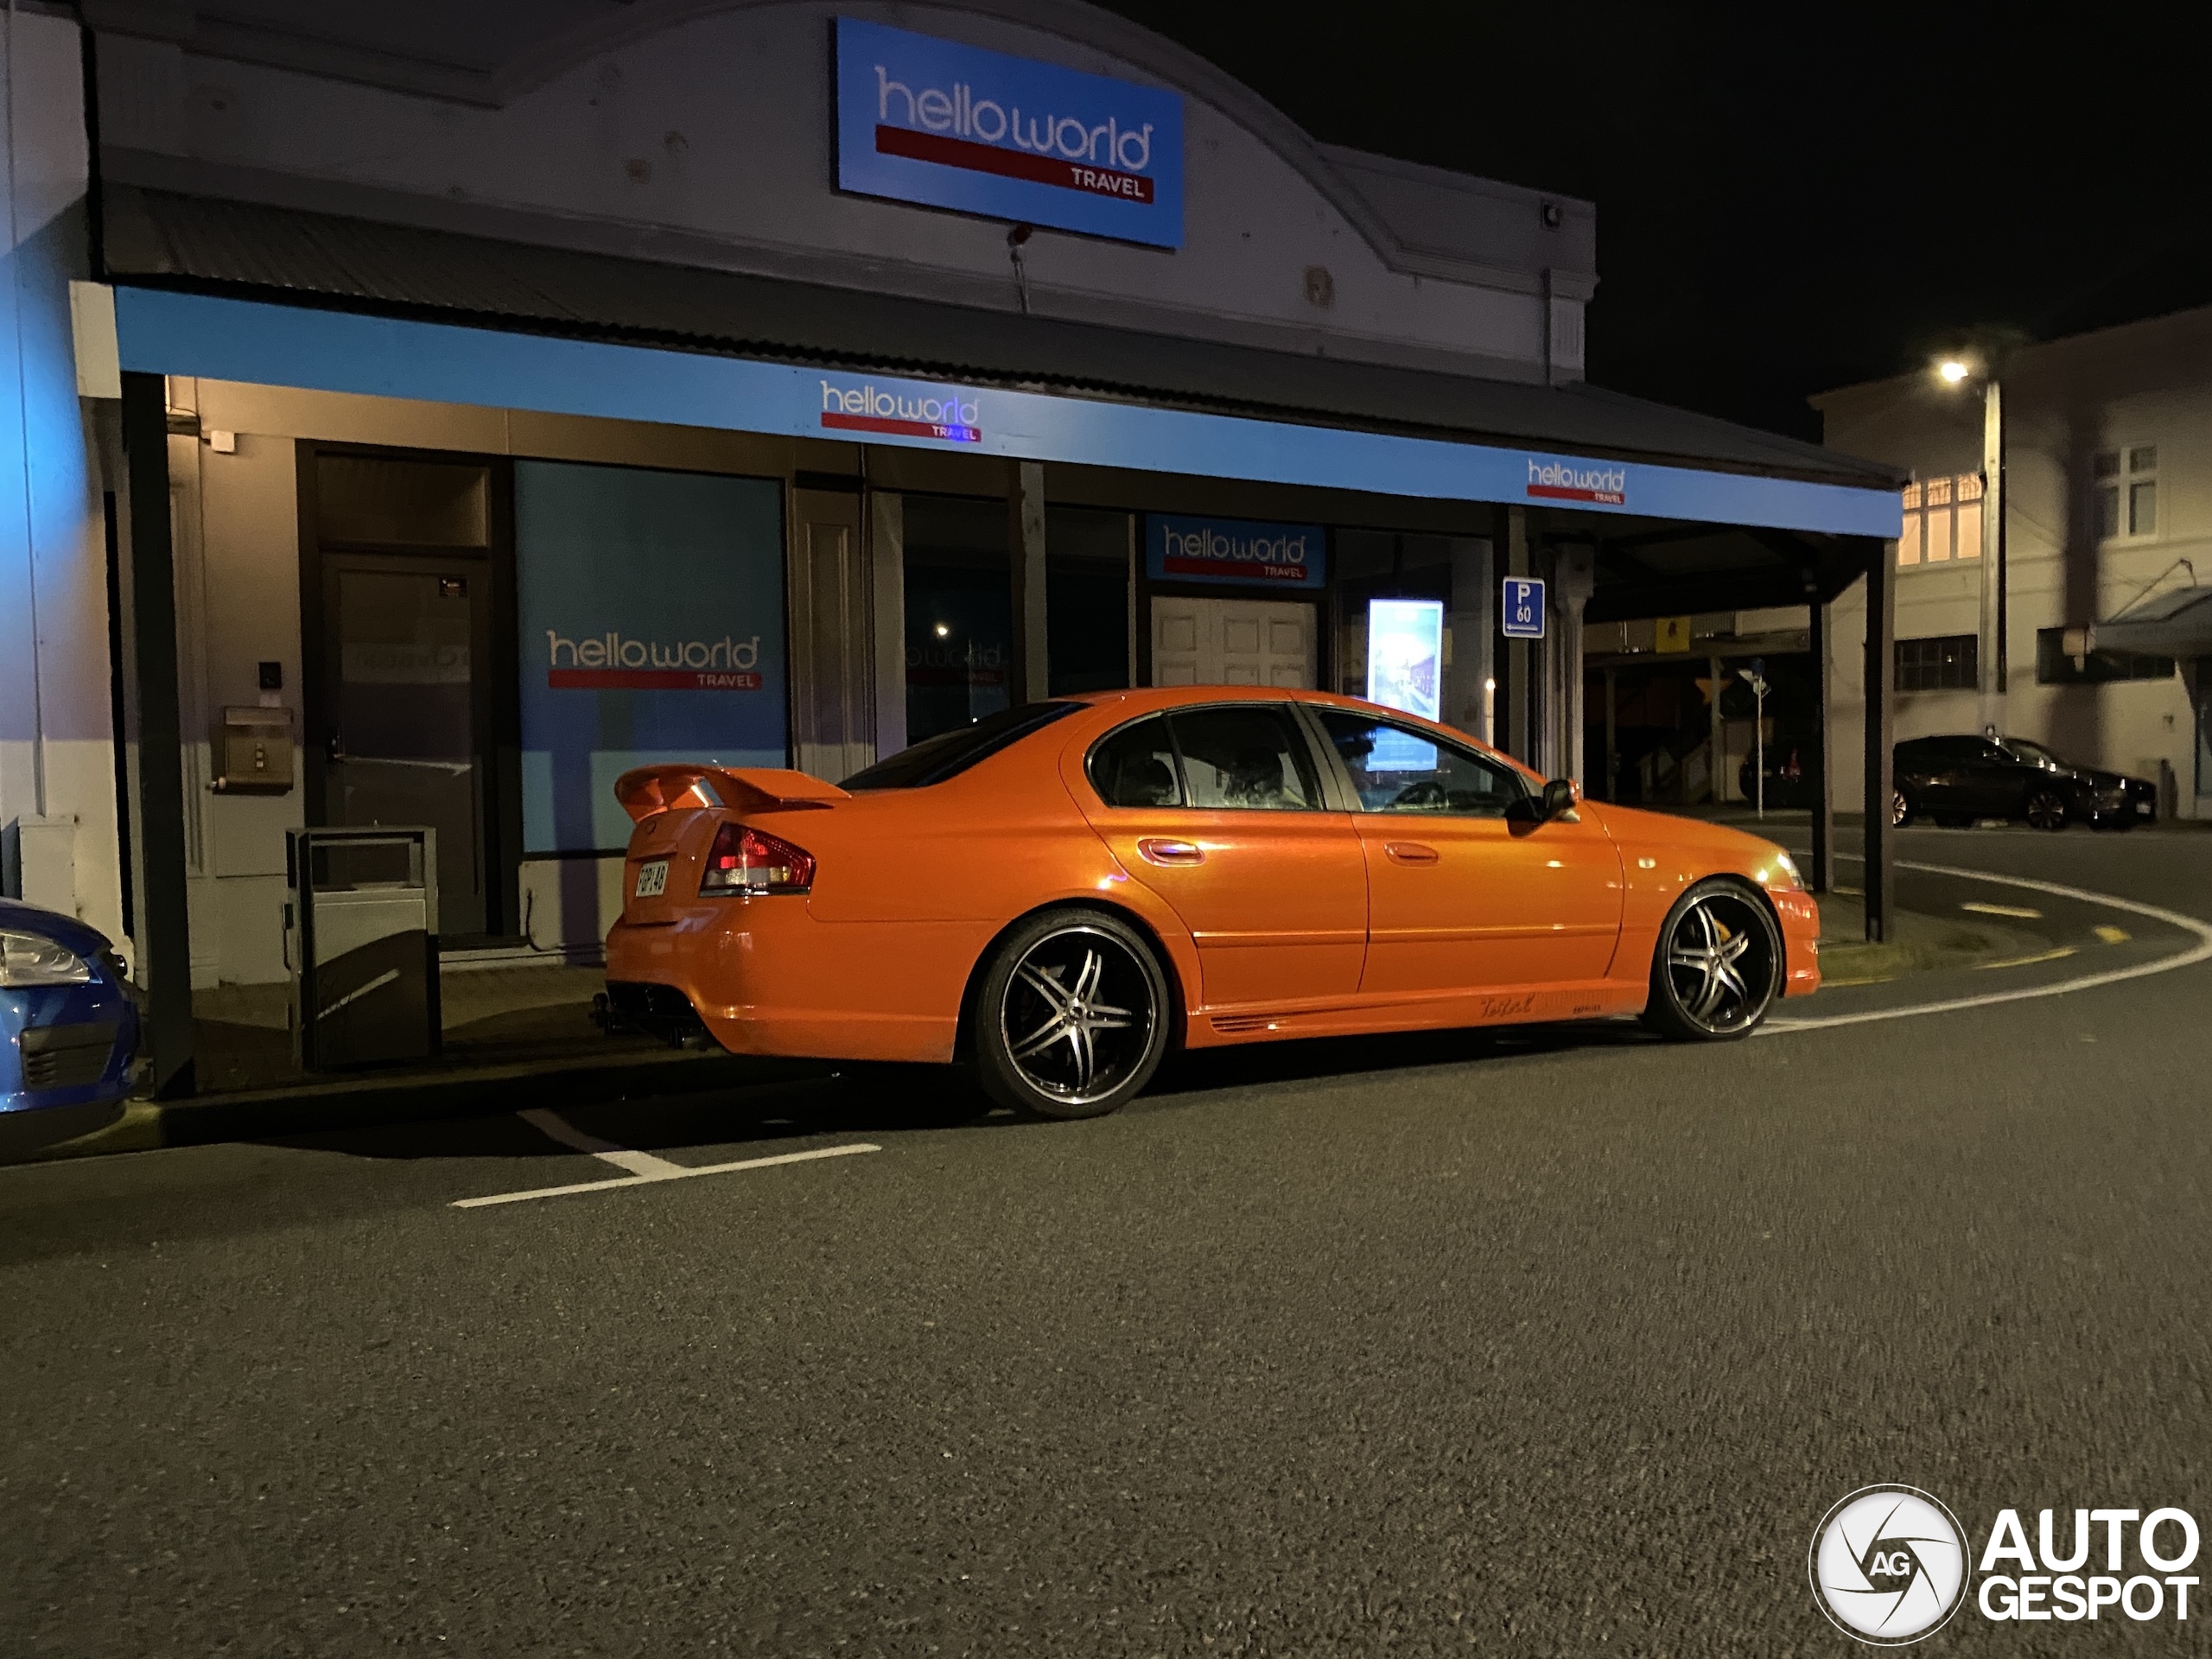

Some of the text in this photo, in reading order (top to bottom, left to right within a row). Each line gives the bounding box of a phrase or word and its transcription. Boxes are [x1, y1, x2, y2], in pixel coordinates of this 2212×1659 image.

[1071, 168, 1145, 198] TRAVEL
[1594, 493, 1621, 504] TRAVEL
[1264, 565, 1302, 578] TRAVEL
[1517, 583, 1530, 604] P
[1516, 606, 1531, 623] 60
[697, 673, 753, 687] TRAVEL
